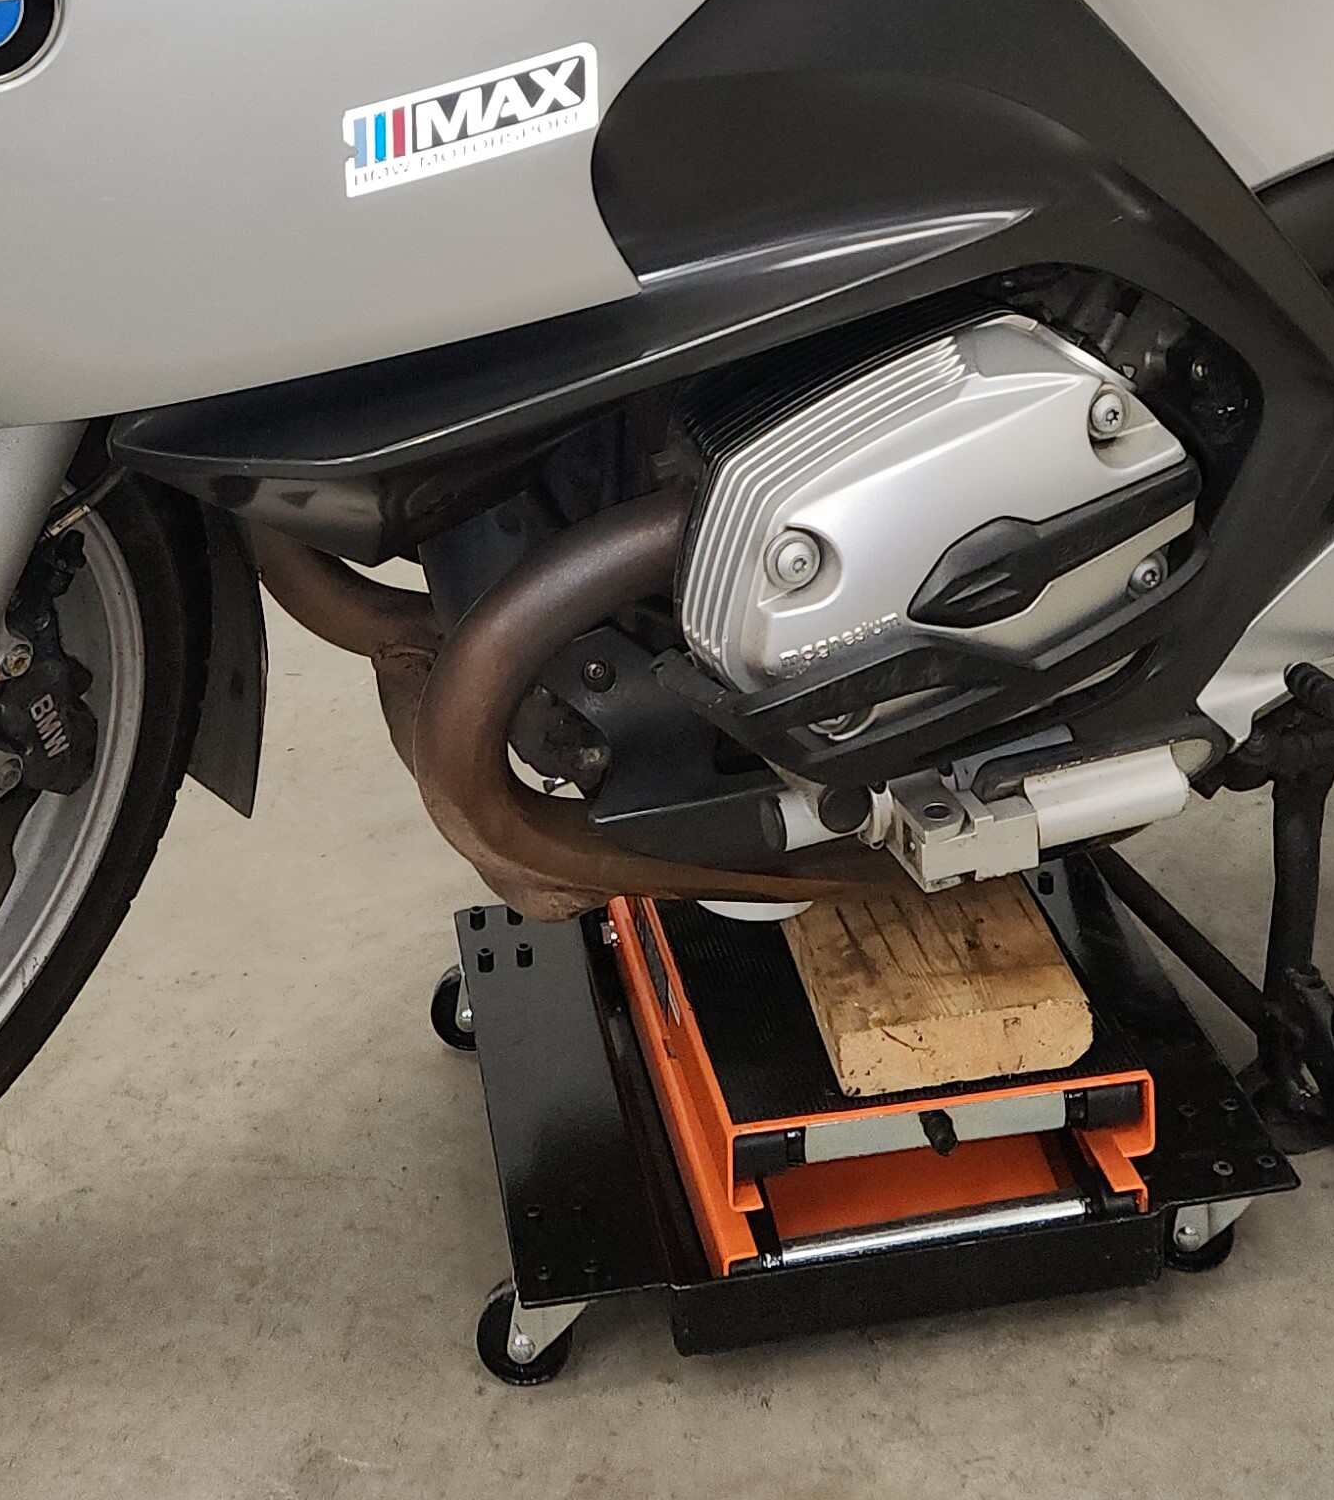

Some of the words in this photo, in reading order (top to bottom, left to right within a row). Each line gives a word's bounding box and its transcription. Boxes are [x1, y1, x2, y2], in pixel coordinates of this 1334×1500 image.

[415, 56, 583, 151] MAX
[778, 612, 900, 675] magnesium
[30, 693, 70, 758] BMW
